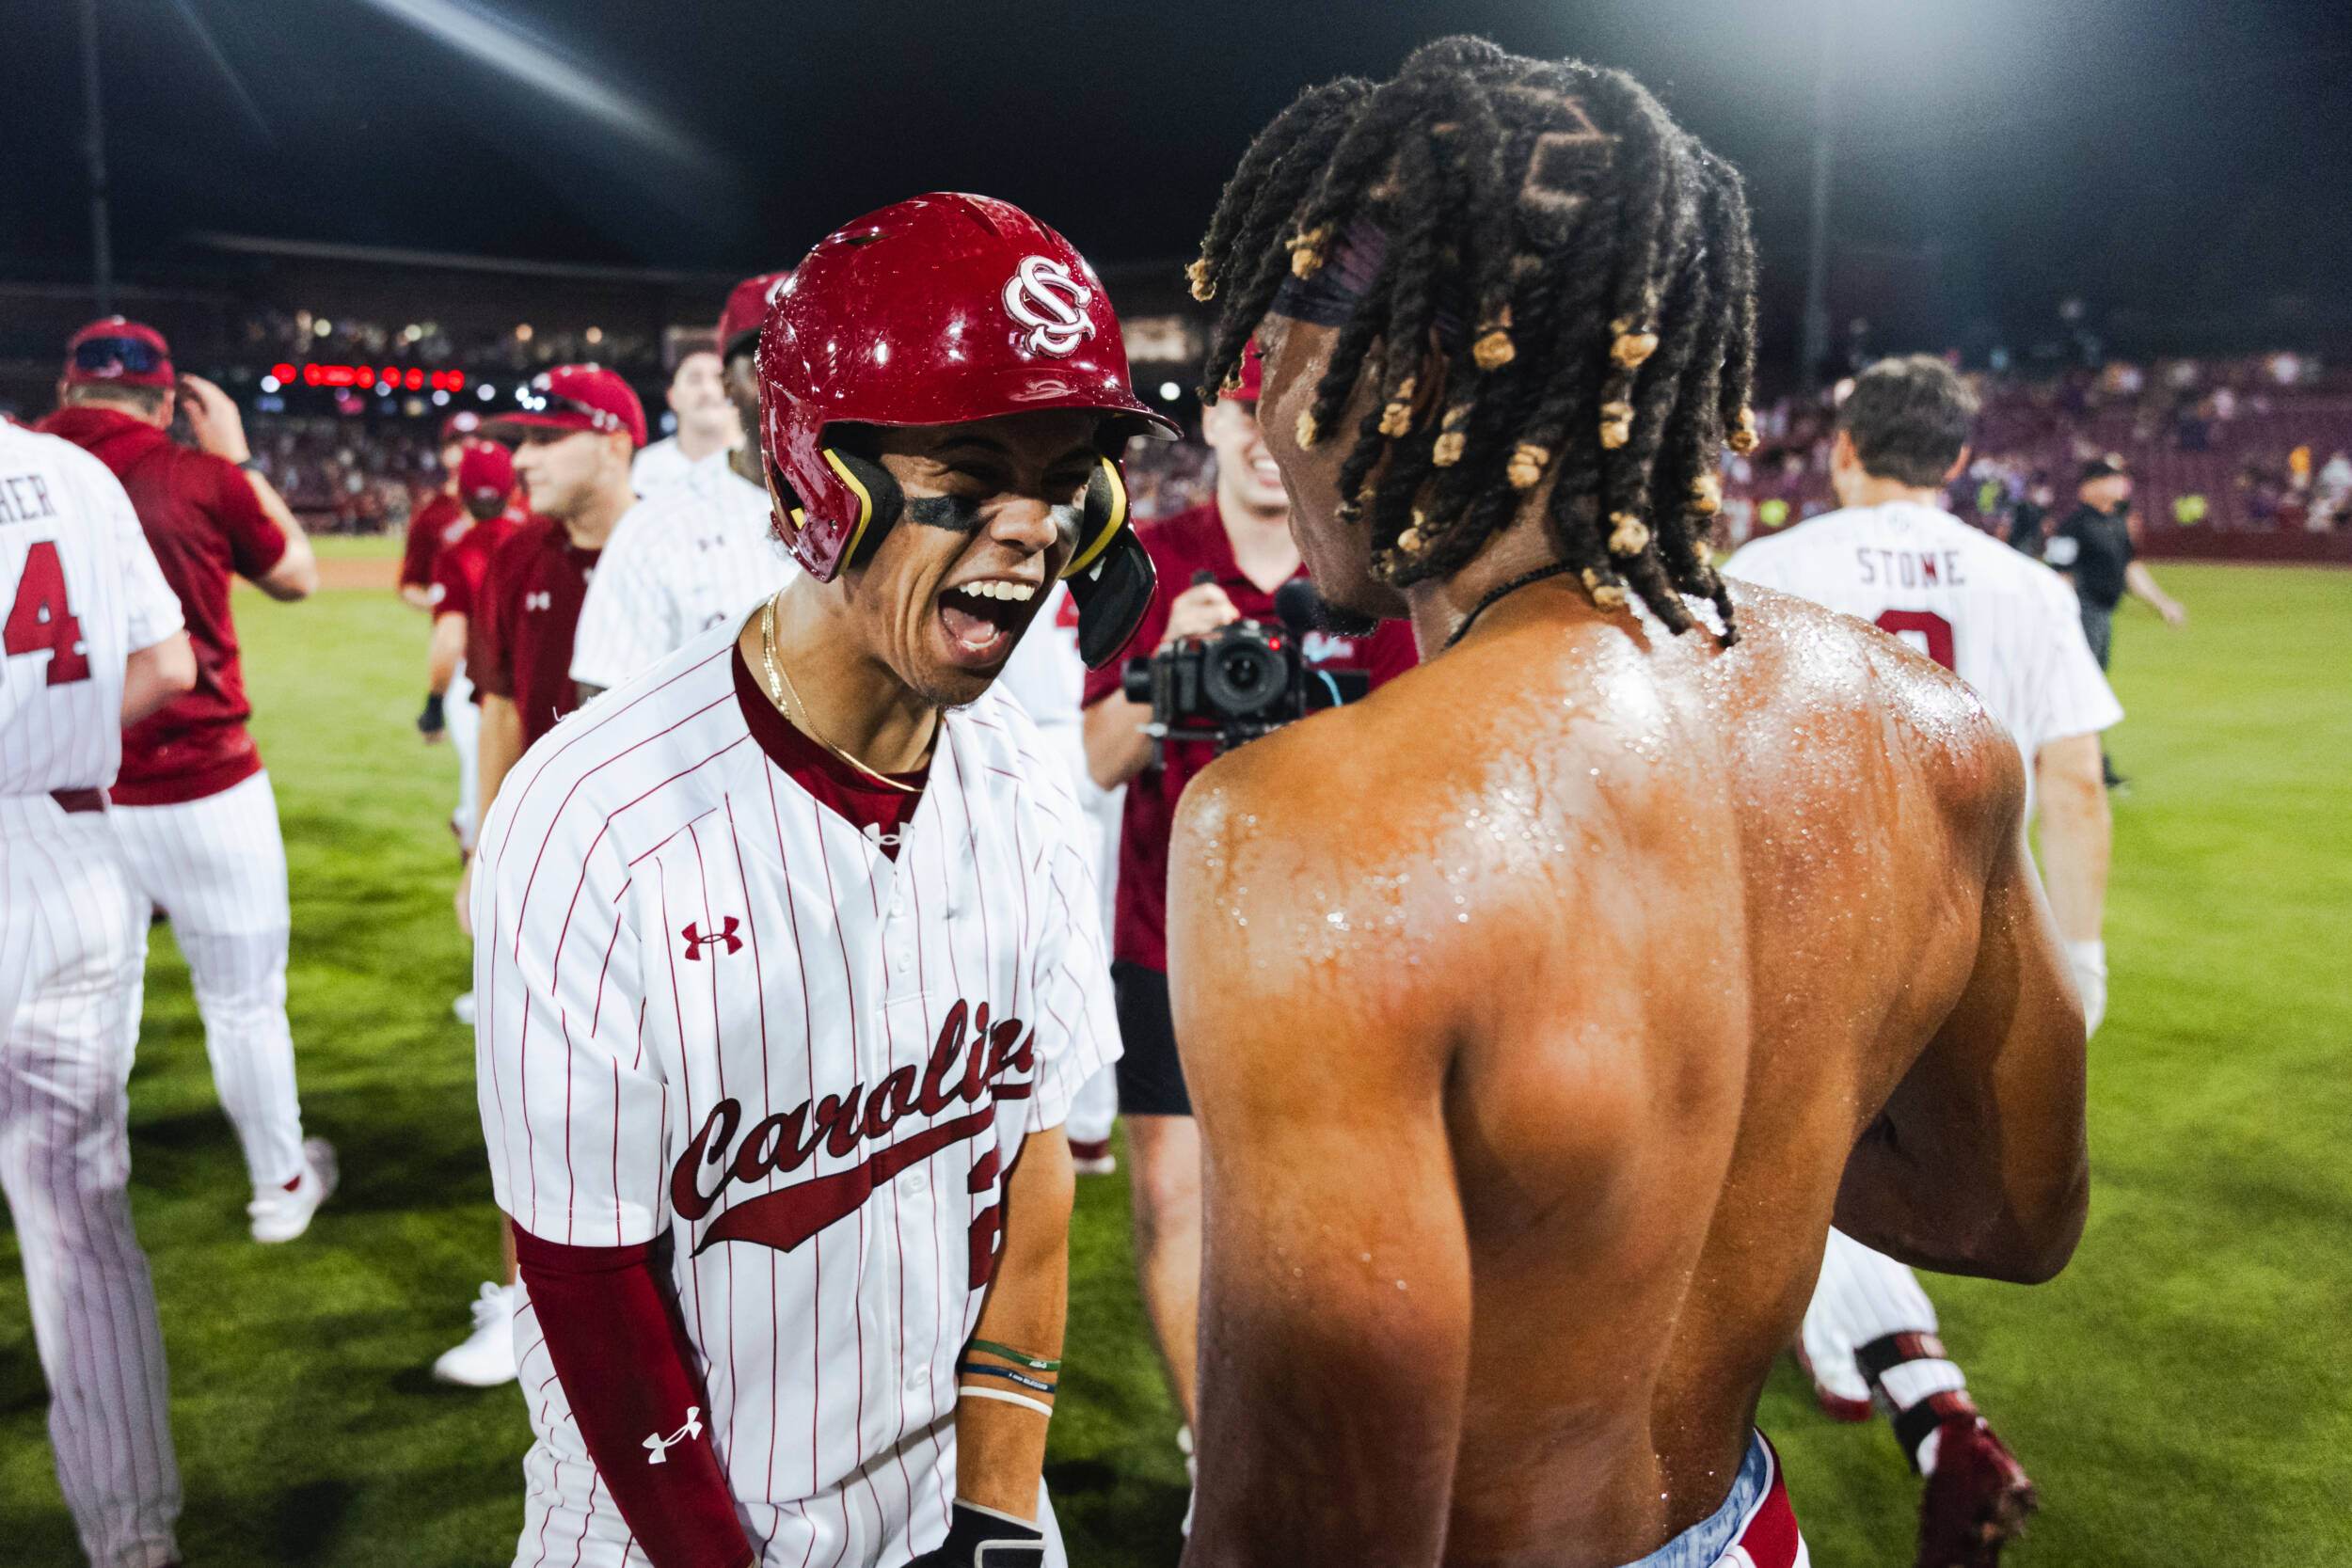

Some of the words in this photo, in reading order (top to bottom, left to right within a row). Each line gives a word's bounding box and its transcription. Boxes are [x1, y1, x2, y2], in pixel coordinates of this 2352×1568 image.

[3, 540, 91, 687] 4
[1856, 547, 1964, 588] STONE
[670, 998, 1034, 1222] Carolin
